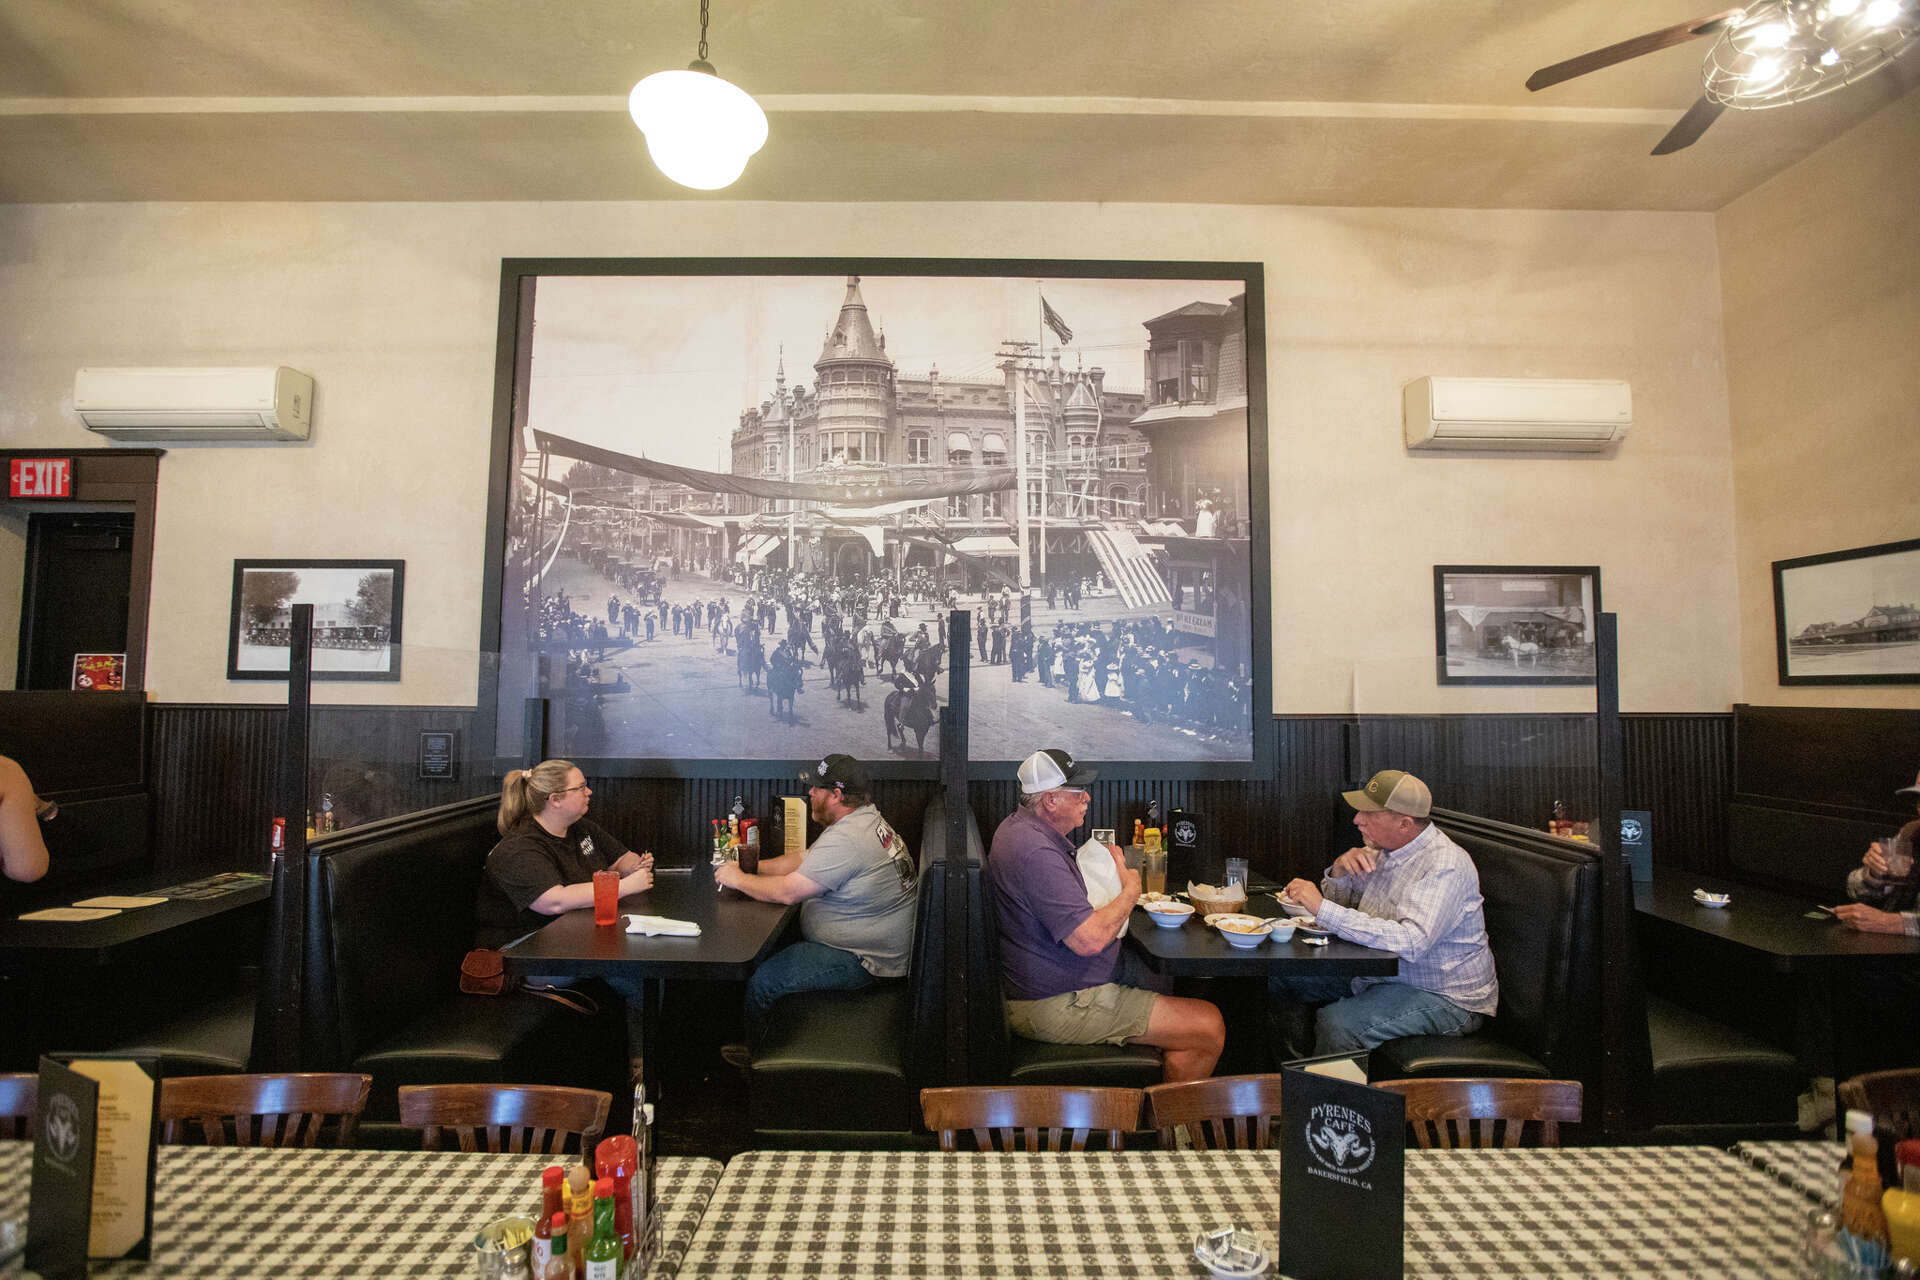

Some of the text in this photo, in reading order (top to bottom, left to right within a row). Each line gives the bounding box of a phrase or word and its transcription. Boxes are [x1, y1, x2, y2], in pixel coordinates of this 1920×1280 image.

[20, 461, 66, 495] EXIT
[1311, 1103, 1372, 1134] PYRENEES
[1324, 1118, 1356, 1133] CAFE
[1361, 1181, 1373, 1191] CA
